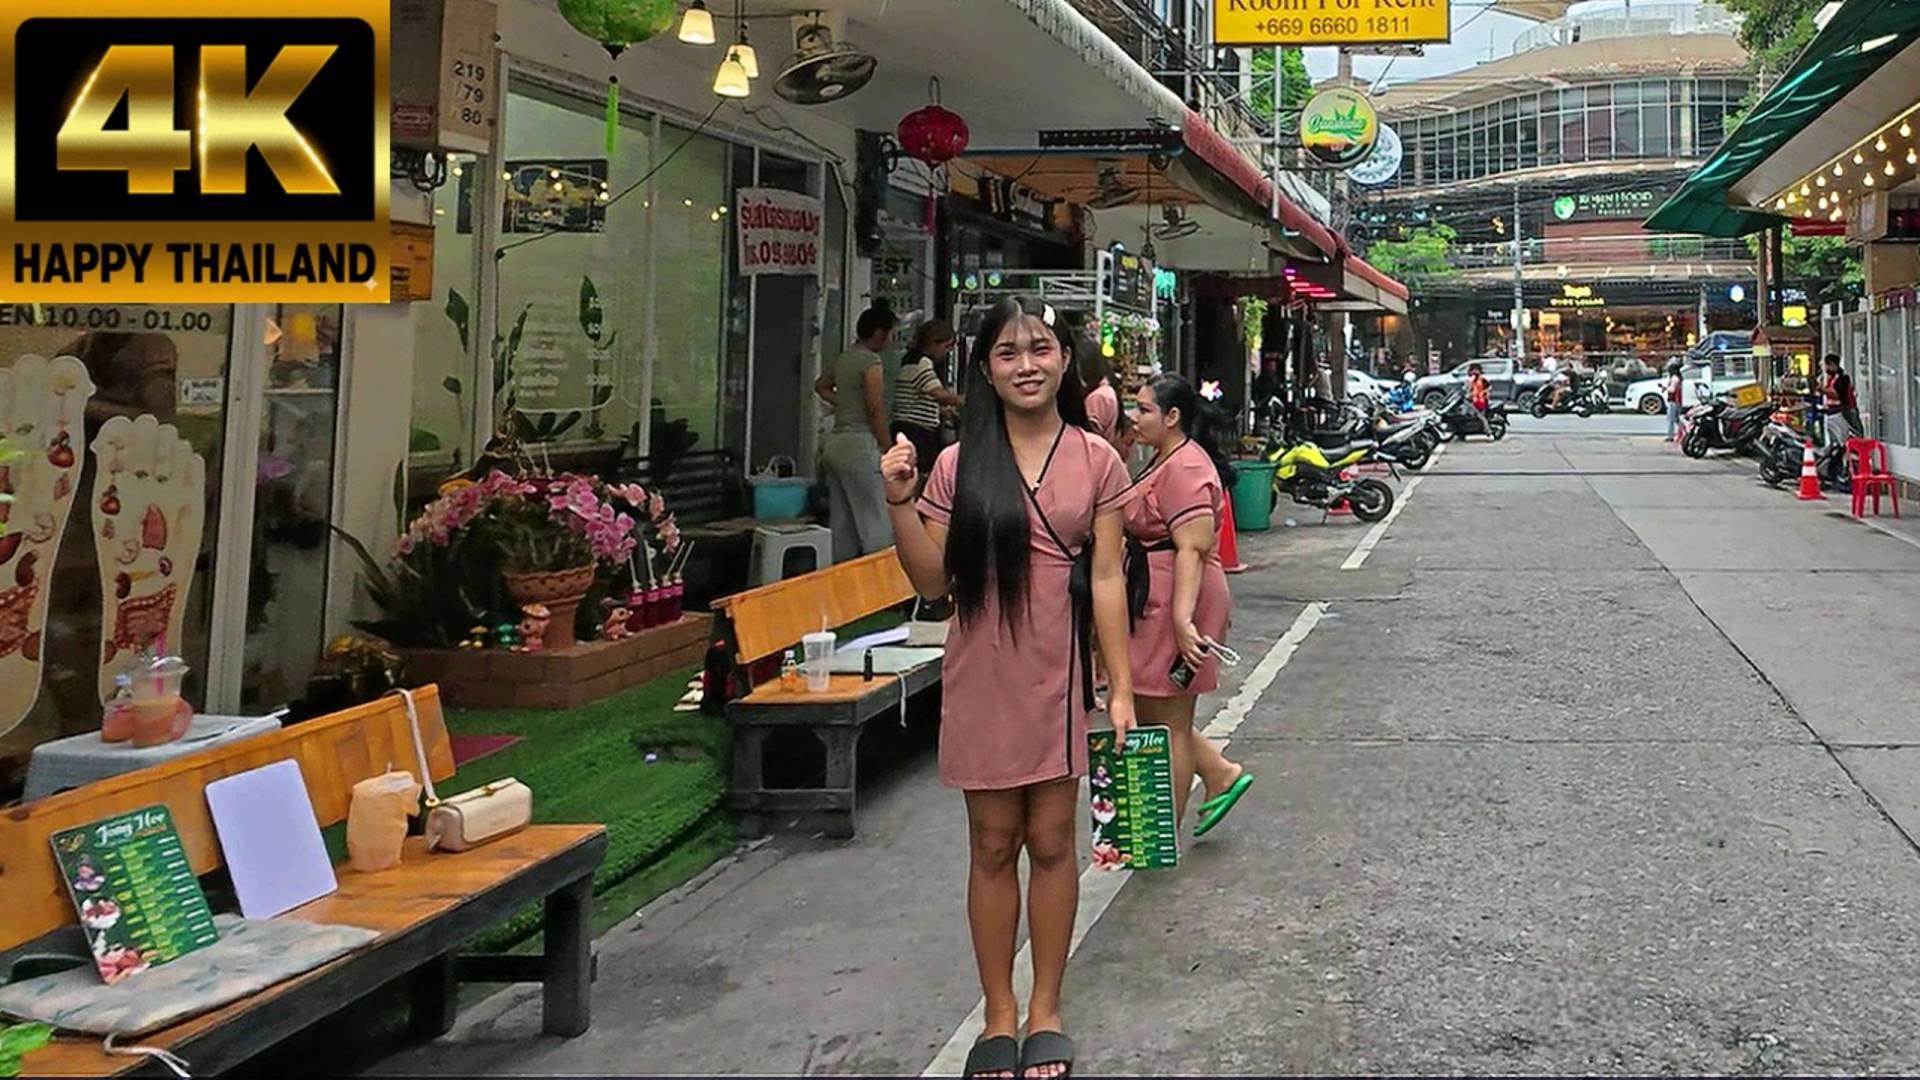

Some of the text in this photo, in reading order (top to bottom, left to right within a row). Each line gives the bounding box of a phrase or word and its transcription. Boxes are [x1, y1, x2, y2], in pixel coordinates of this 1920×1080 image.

[1256, 16, 1410, 36] +669 6660 1811
[455, 60, 485, 82] 219
[44, 305, 120, 329] 10.00
[143, 309, 212, 332] 01.00
